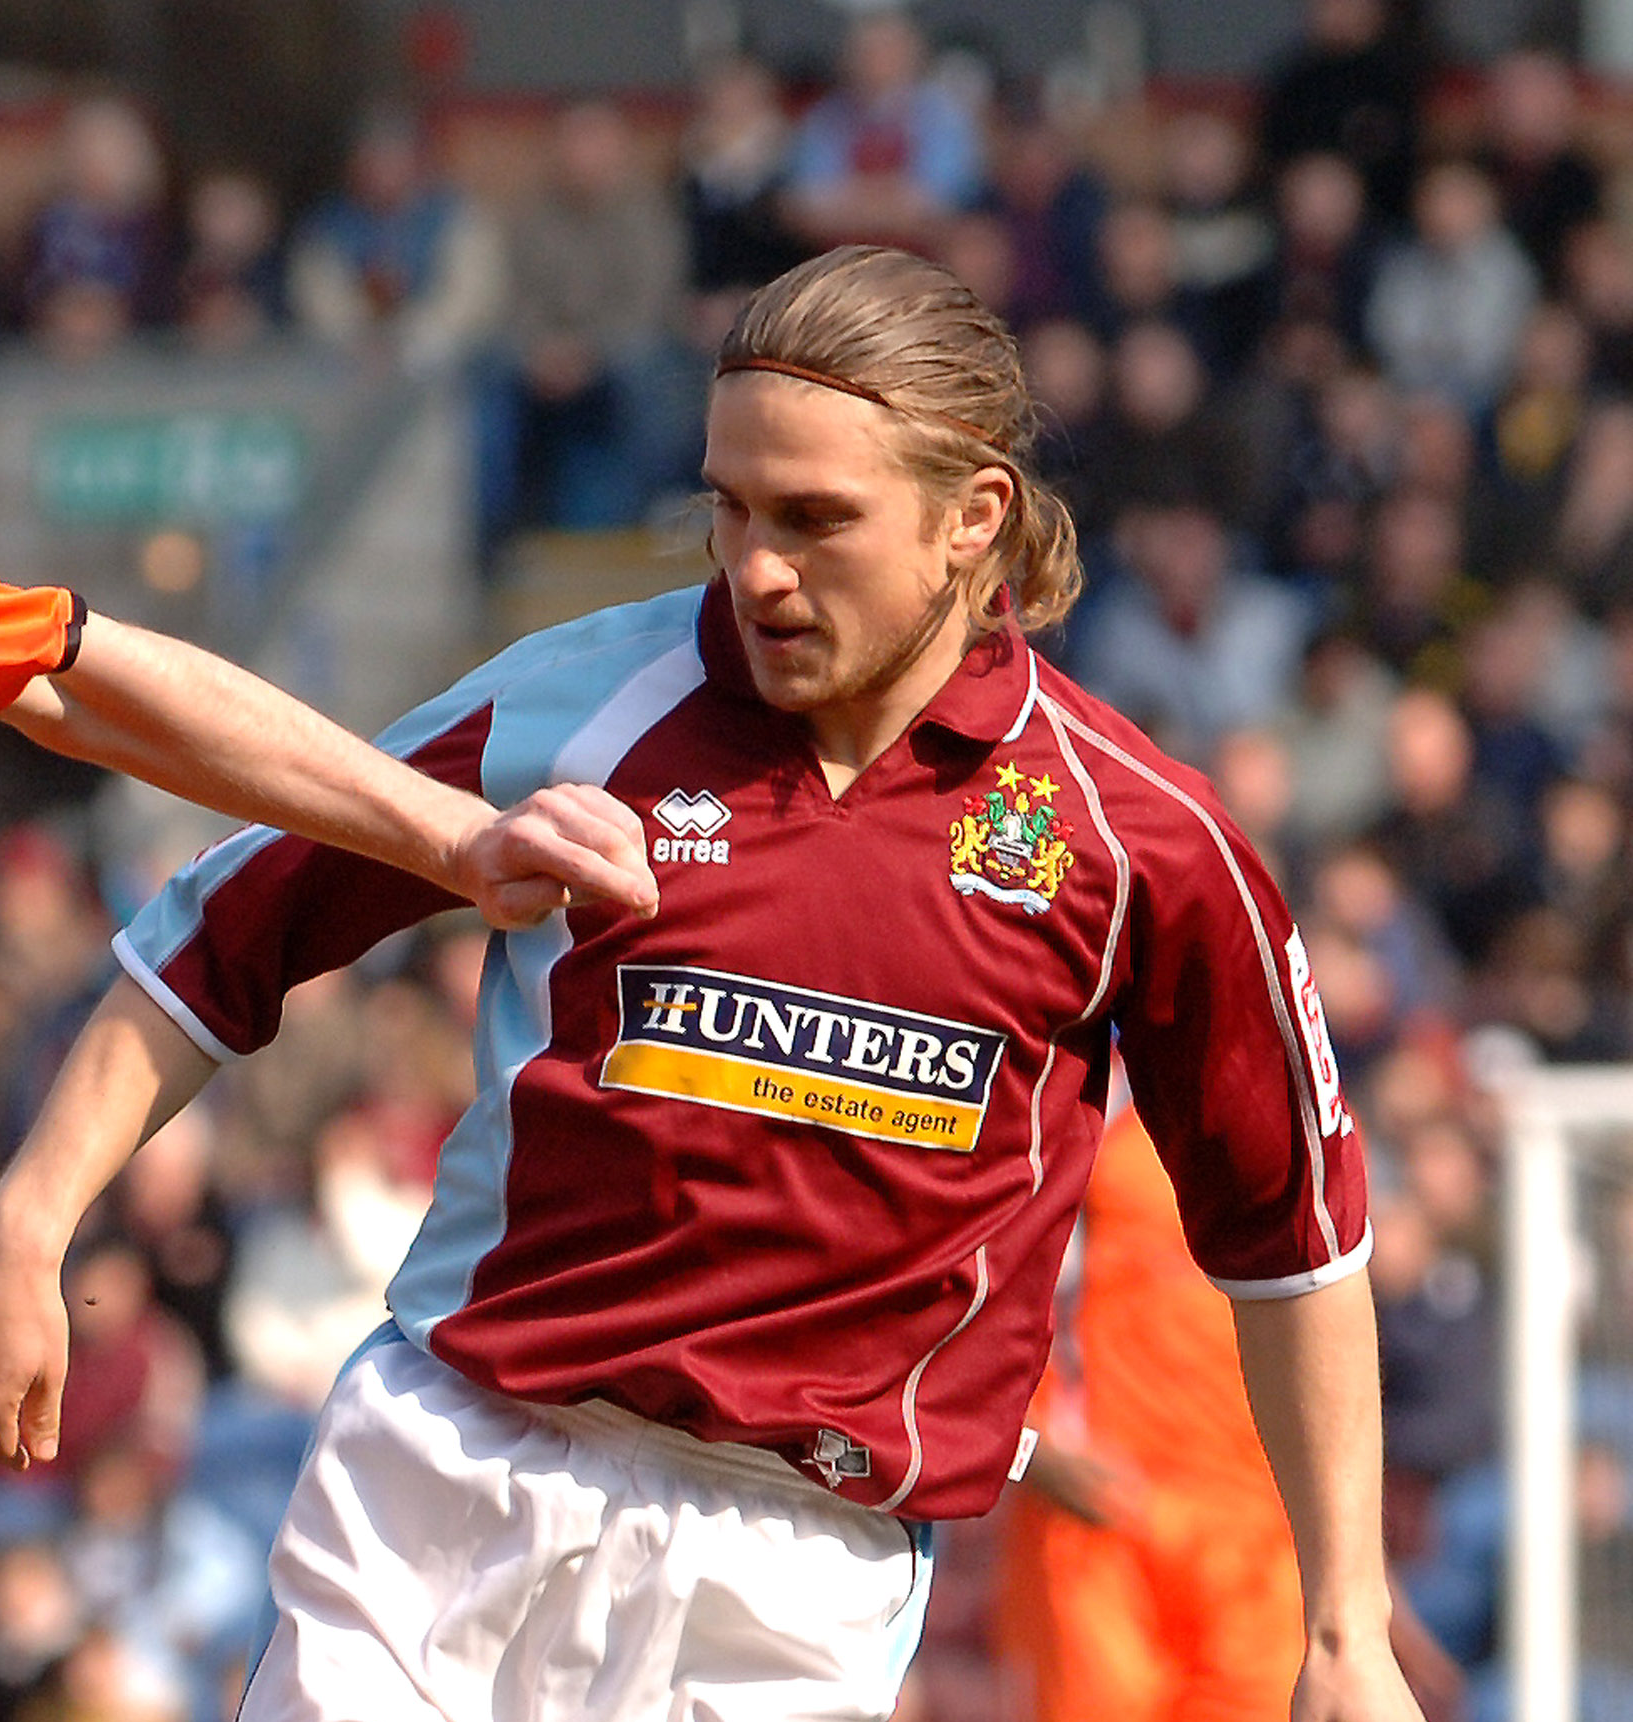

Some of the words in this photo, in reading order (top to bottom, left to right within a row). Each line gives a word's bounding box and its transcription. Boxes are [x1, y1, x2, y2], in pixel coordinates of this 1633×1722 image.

[653, 837, 730, 865] errea
[642, 982, 980, 1091] HUNTERS
[752, 1075, 794, 1103] the
[803, 1088, 884, 1124] estate
[890, 1108, 958, 1136] agent
